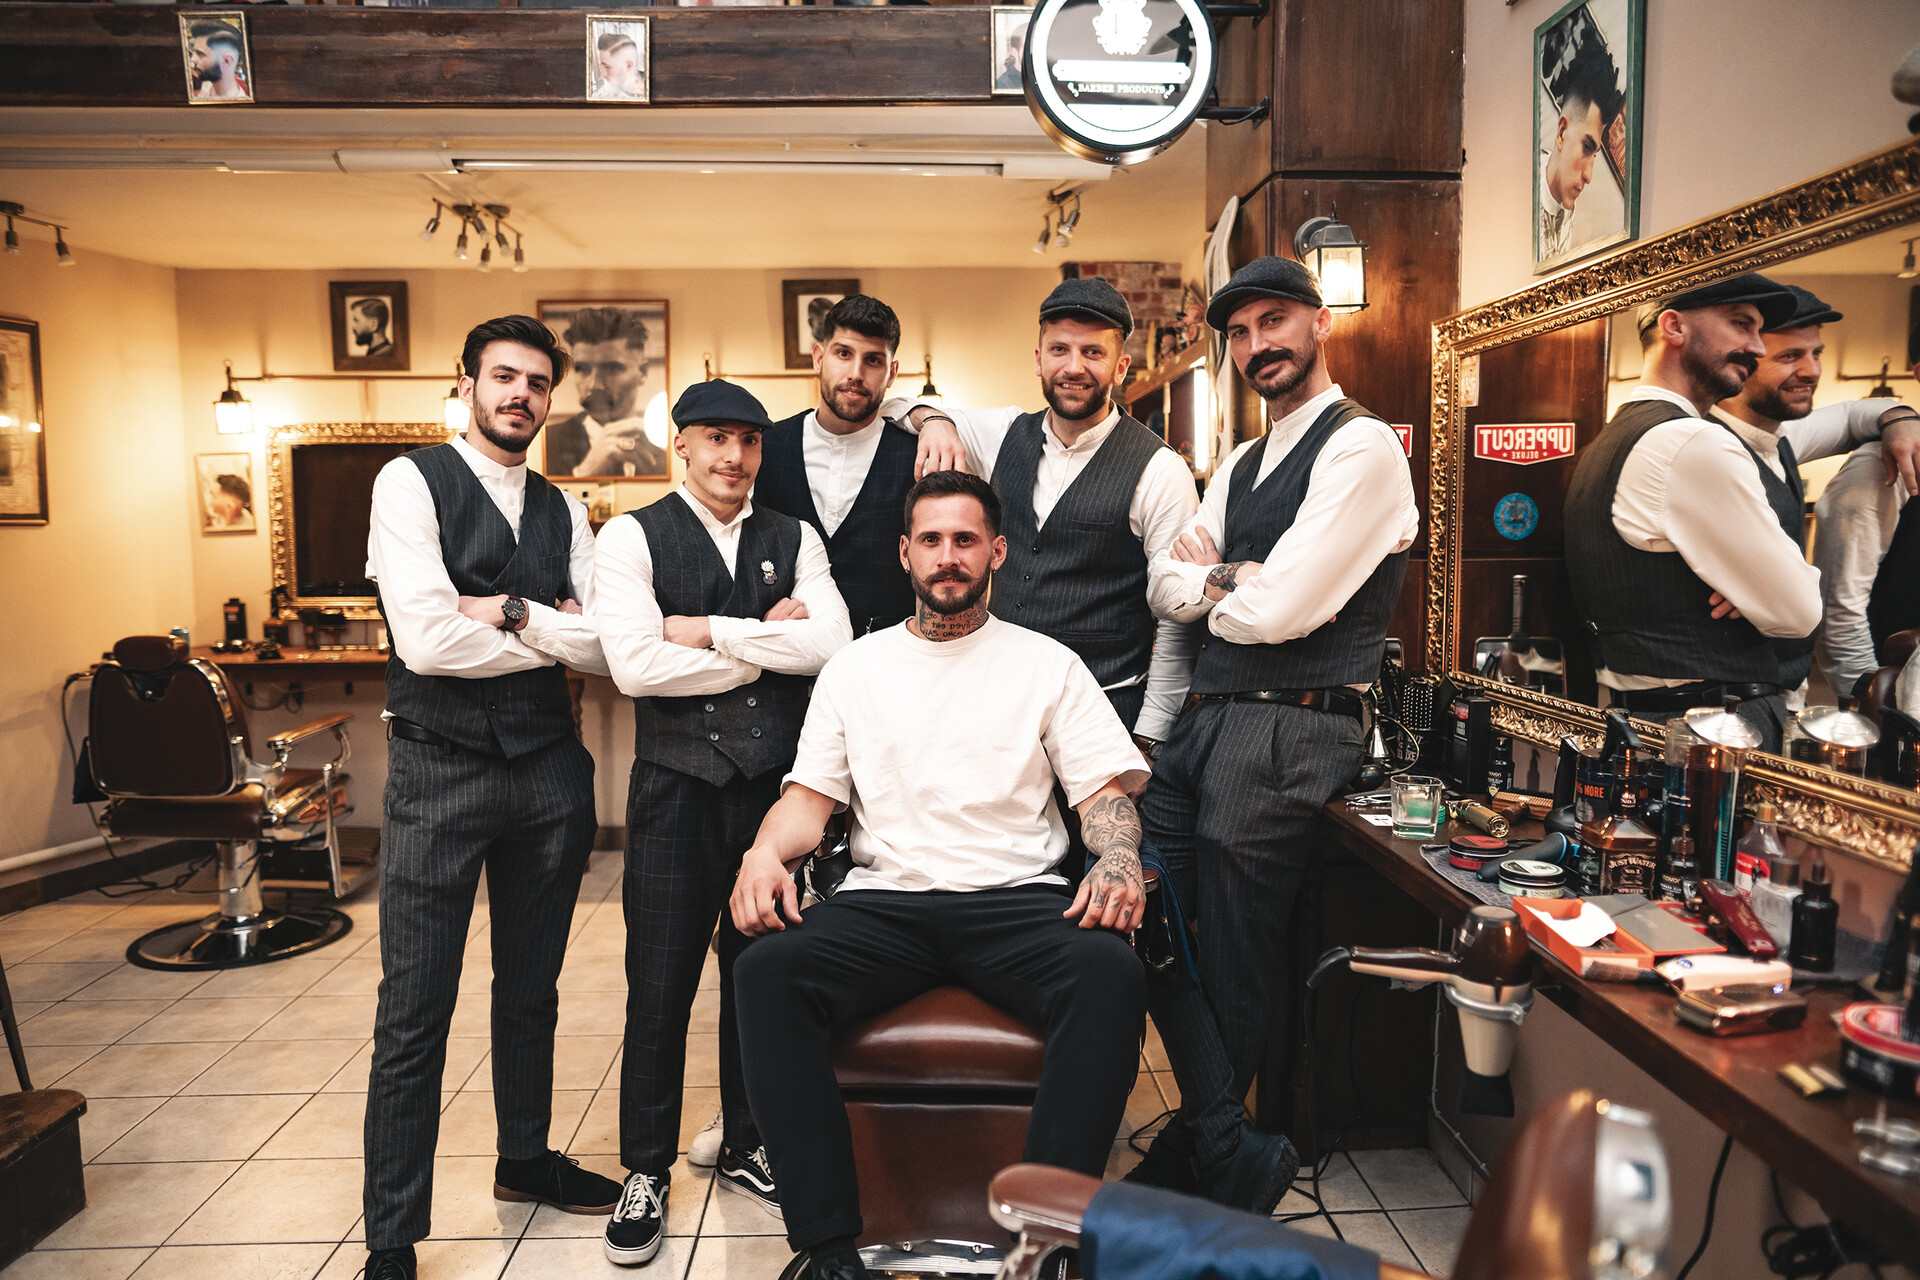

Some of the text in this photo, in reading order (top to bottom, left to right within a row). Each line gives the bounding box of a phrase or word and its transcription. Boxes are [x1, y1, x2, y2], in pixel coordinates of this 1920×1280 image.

[1078, 83, 1165, 94] BARBER PRODUCTS
[1584, 784, 1605, 799] MORE
[1608, 857, 1657, 869] JUST WATER
